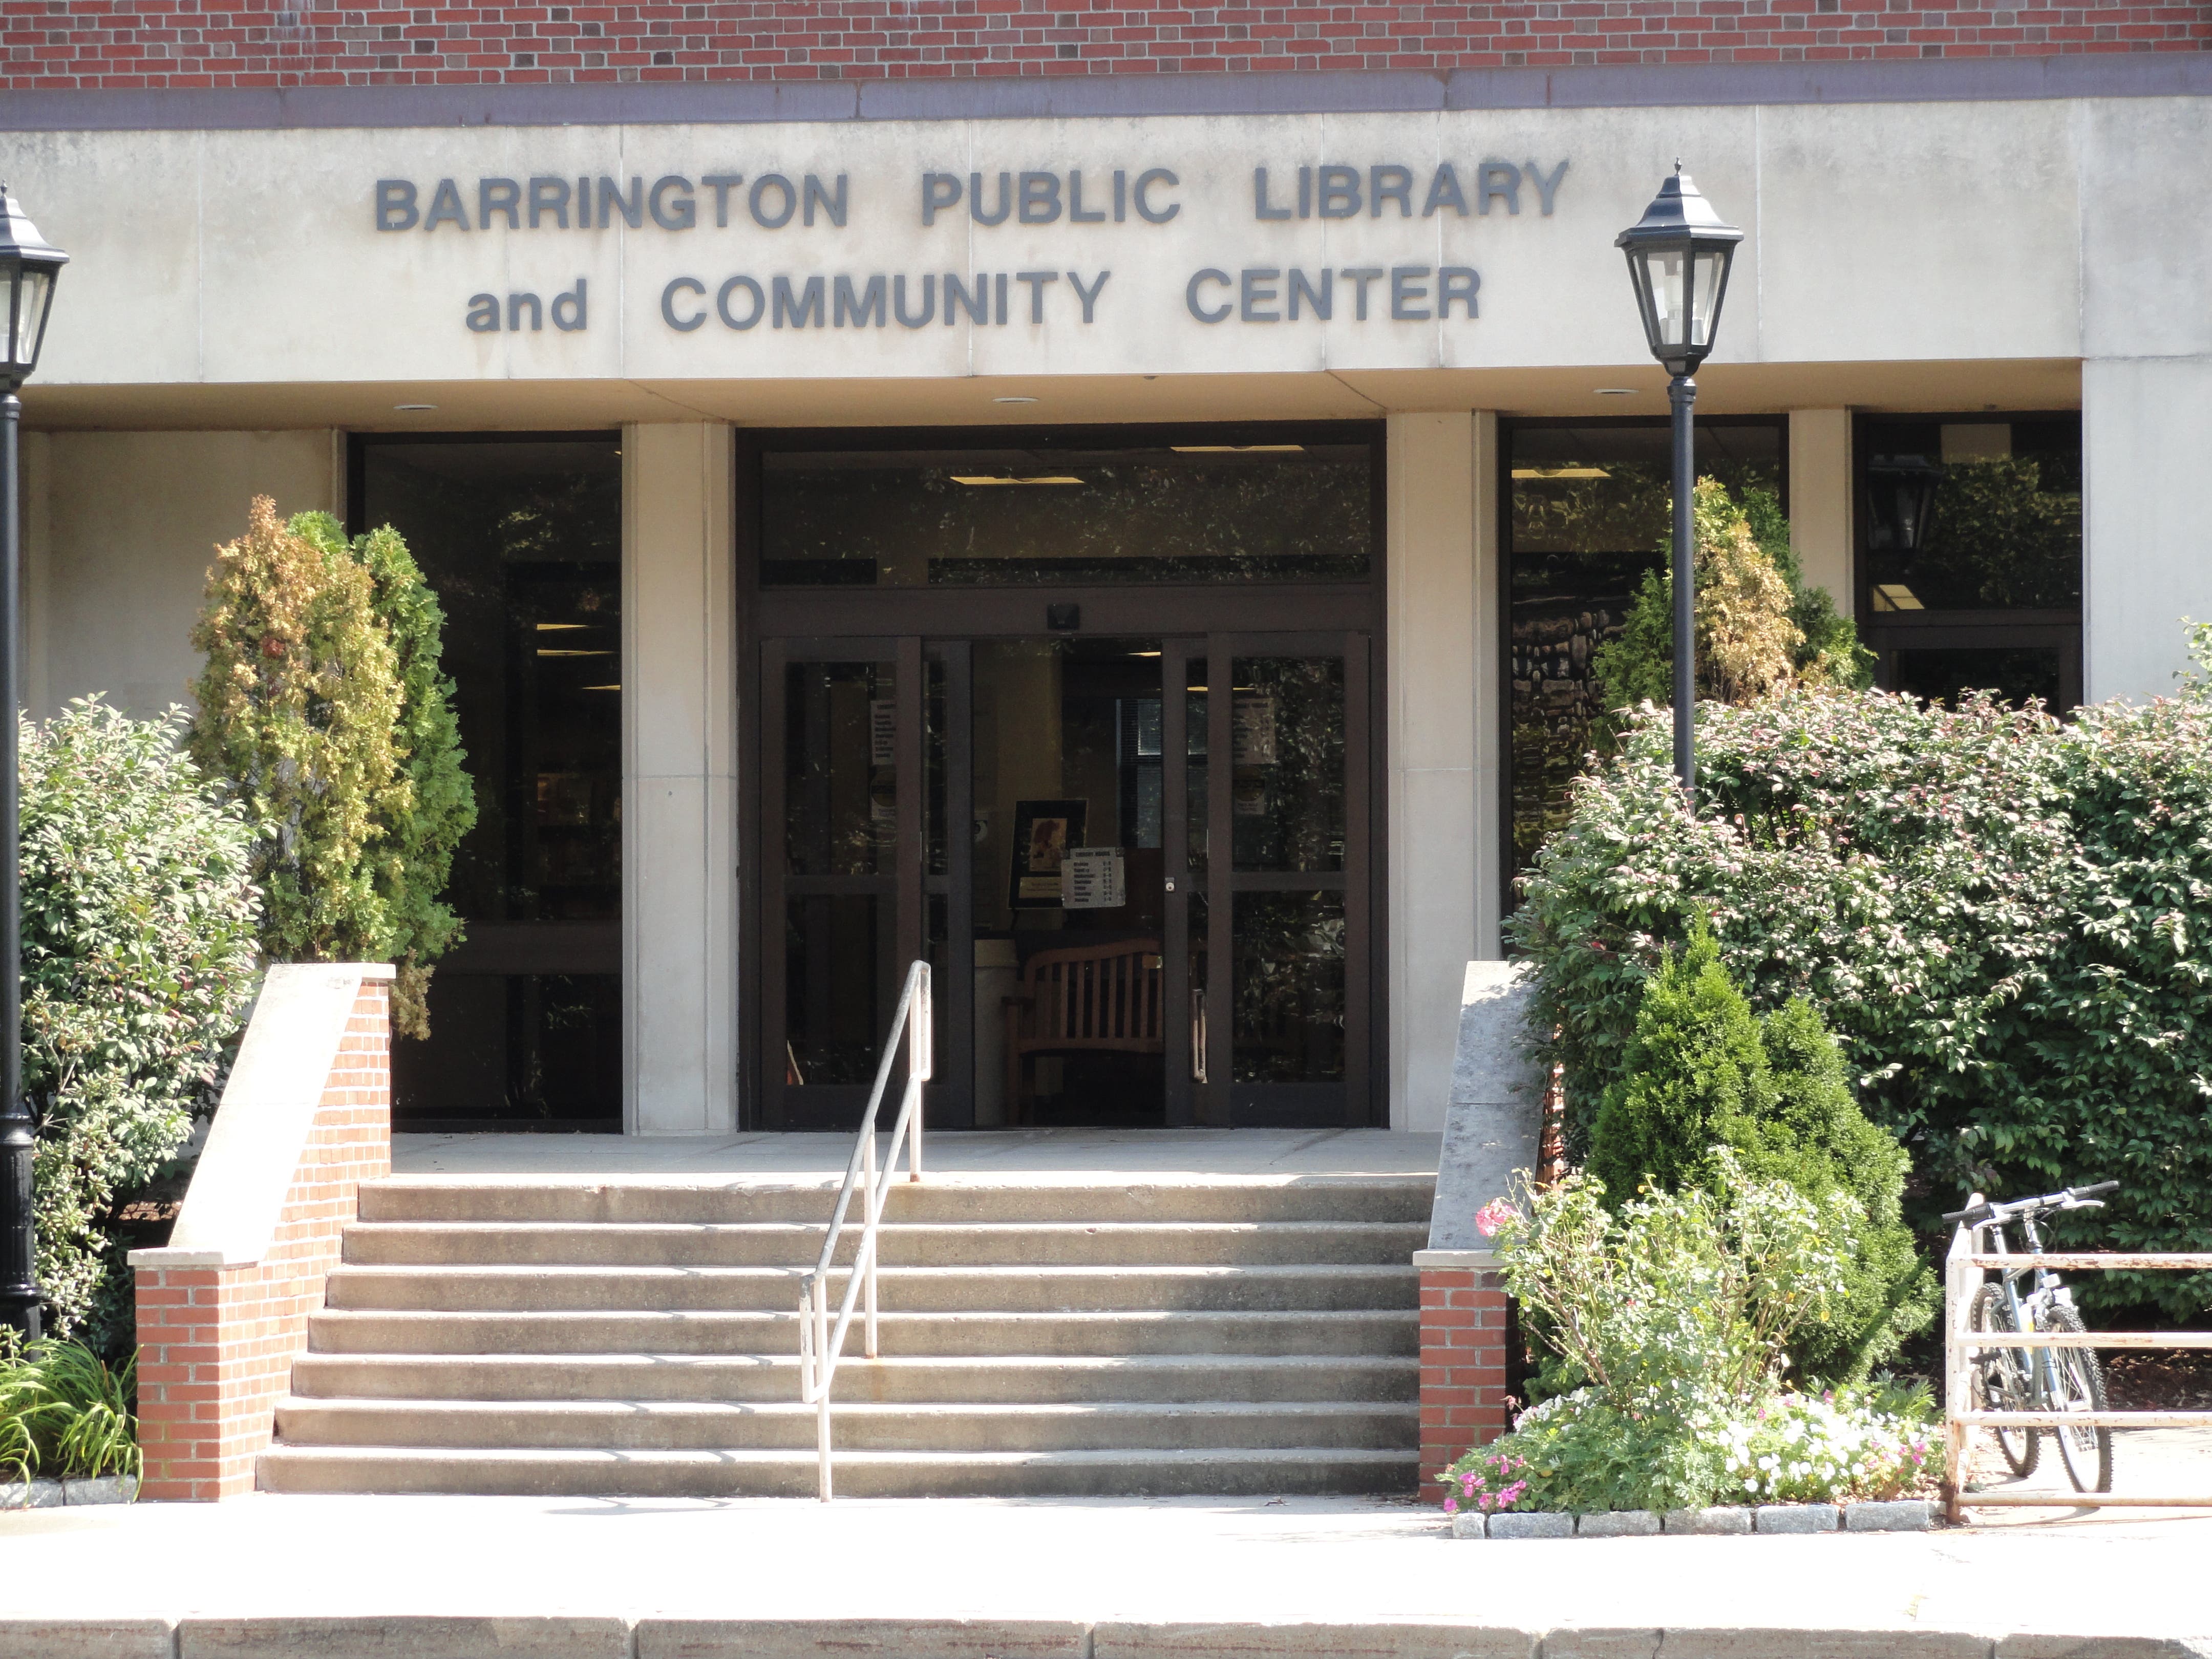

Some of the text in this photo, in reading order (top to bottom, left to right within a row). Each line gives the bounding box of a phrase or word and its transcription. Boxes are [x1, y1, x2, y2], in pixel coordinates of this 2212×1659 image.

[376, 161, 1570, 231] BARRINGTON PUBLIC LIBRARY
[466, 267, 1480, 331] and COMMUNITY CENTER
